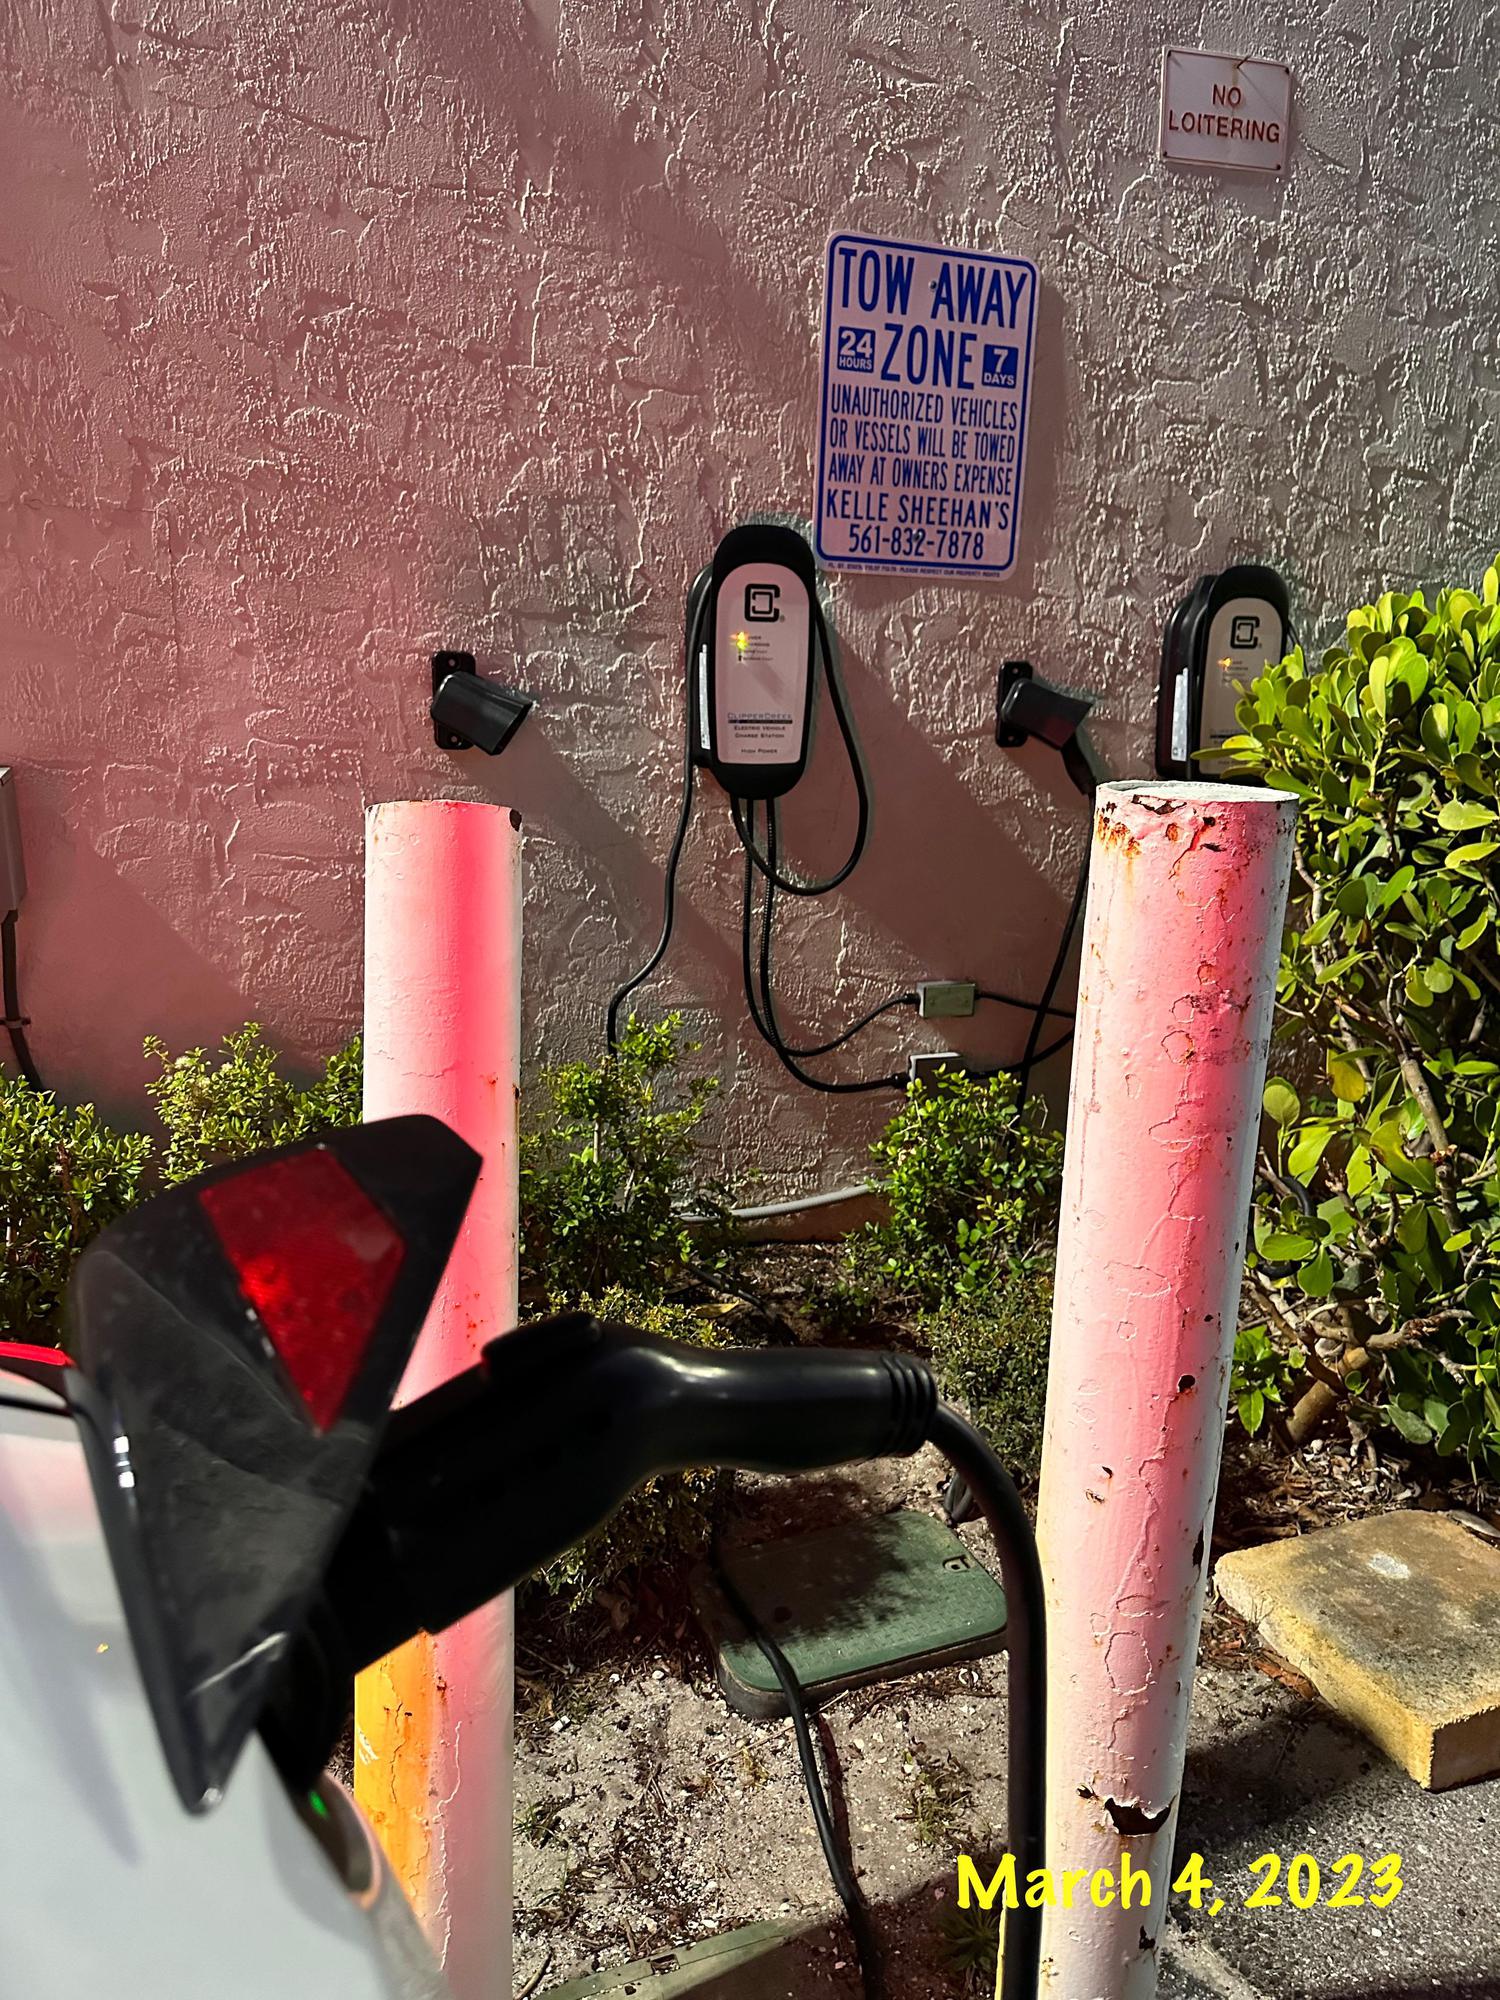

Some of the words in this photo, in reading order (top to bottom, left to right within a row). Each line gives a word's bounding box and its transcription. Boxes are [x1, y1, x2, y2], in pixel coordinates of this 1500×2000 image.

[1212, 84, 1242, 106] NO
[1168, 109, 1280, 144] LOITERING
[838, 247, 915, 316] TOW
[930, 261, 1028, 330] AWAY
[839, 330, 873, 359] 24
[880, 323, 978, 390] ZONE
[992, 348, 1010, 374] 7
[838, 356, 873, 371] HOURS
[983, 373, 1015, 386] DAYS
[831, 383, 944, 424] UNAUTHORIZED
[951, 396, 1018, 432] VEHICLES
[829, 417, 848, 449] OR
[855, 420, 911, 455] VESSELS
[917, 426, 946, 458] WILL
[951, 430, 969, 460] BE
[974, 432, 1015, 464] TOWED
[828, 452, 865, 485] AWAY
[870, 457, 887, 486] AT
[892, 457, 948, 492] OWNERS
[953, 463, 1013, 496] EXPENSE
[826, 488, 889, 522] KELLE
[897, 494, 1010, 530] SHEEHAN'S
[848, 524, 984, 560] 561-832-7878
